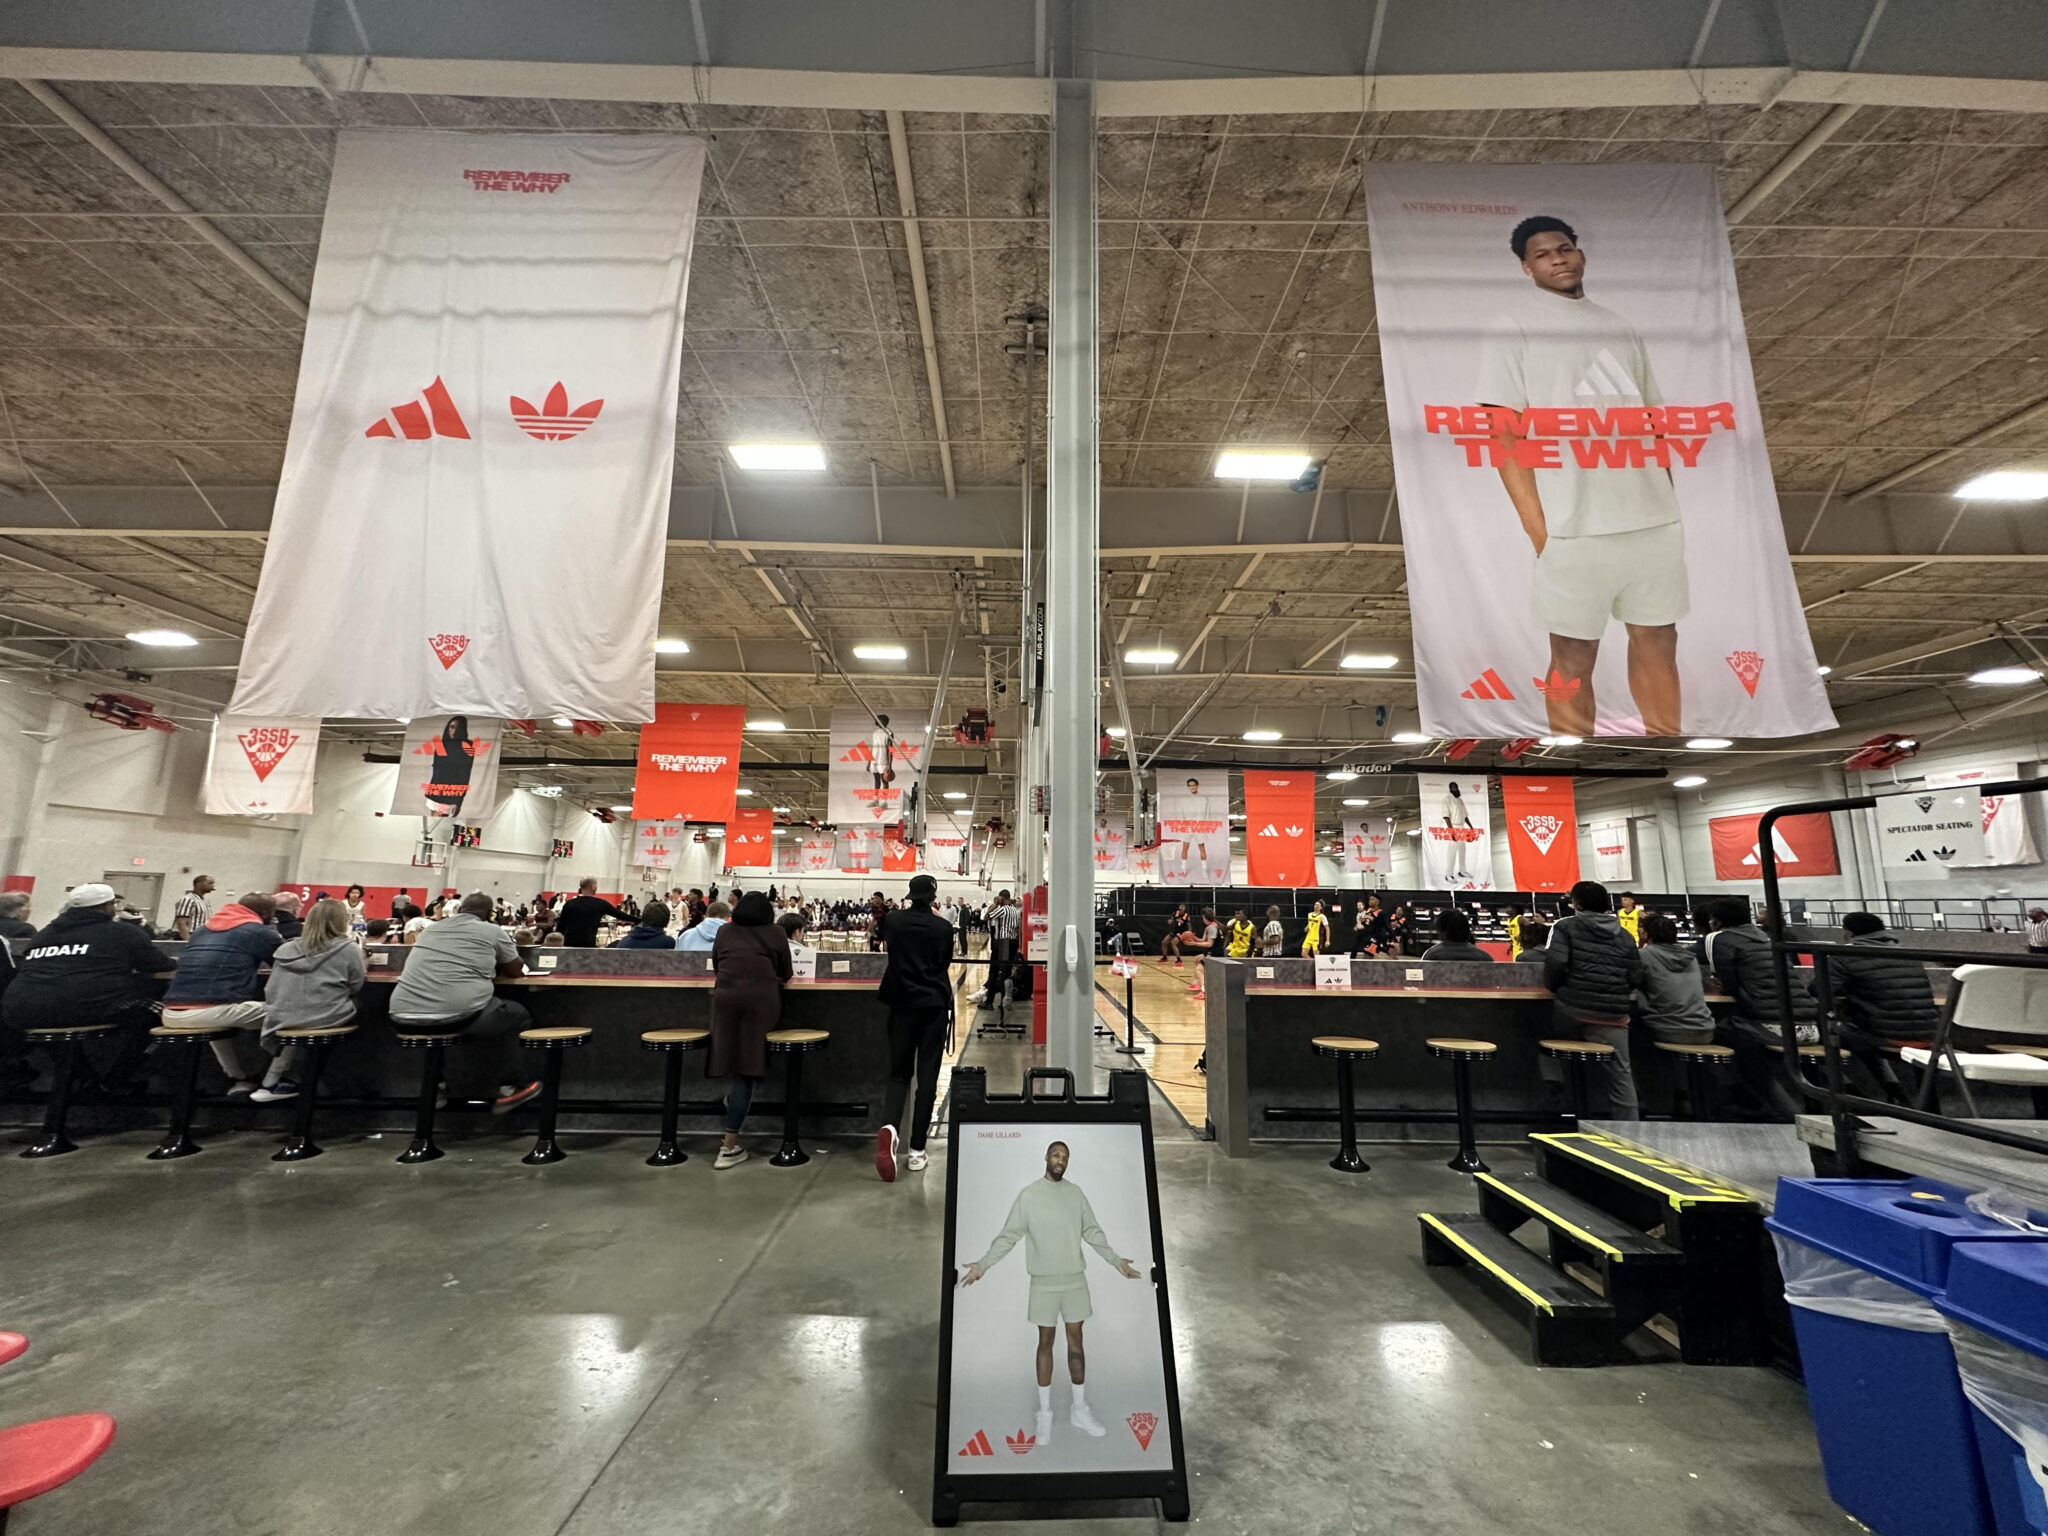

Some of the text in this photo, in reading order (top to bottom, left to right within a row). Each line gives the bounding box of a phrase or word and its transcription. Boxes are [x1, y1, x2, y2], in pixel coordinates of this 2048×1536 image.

[463, 169, 571, 183] REMEMBER
[474, 181, 559, 193] THE WHY
[1402, 202, 1518, 215] ANTHONY EDWARDS
[1424, 402, 1736, 437] REMEMBER
[1454, 437, 1707, 469] THE WHY
[436, 633, 466, 648] 3SSB
[247, 728, 290, 748] 3SSB
[651, 753, 728, 765] REMEMBER
[658, 762, 720, 773] THE WHY
[1164, 820, 1223, 828] REMEMBER
[1526, 815, 1556, 831] 3SSB
[1887, 820, 1974, 834] SPECTATOR SEATING
[1428, 827, 1485, 836] REMEMBER
[1432, 833, 1480, 842] THE WHY
[25, 944, 90, 960] JUDAH
[1131, 1413, 1153, 1426] 3SSB
